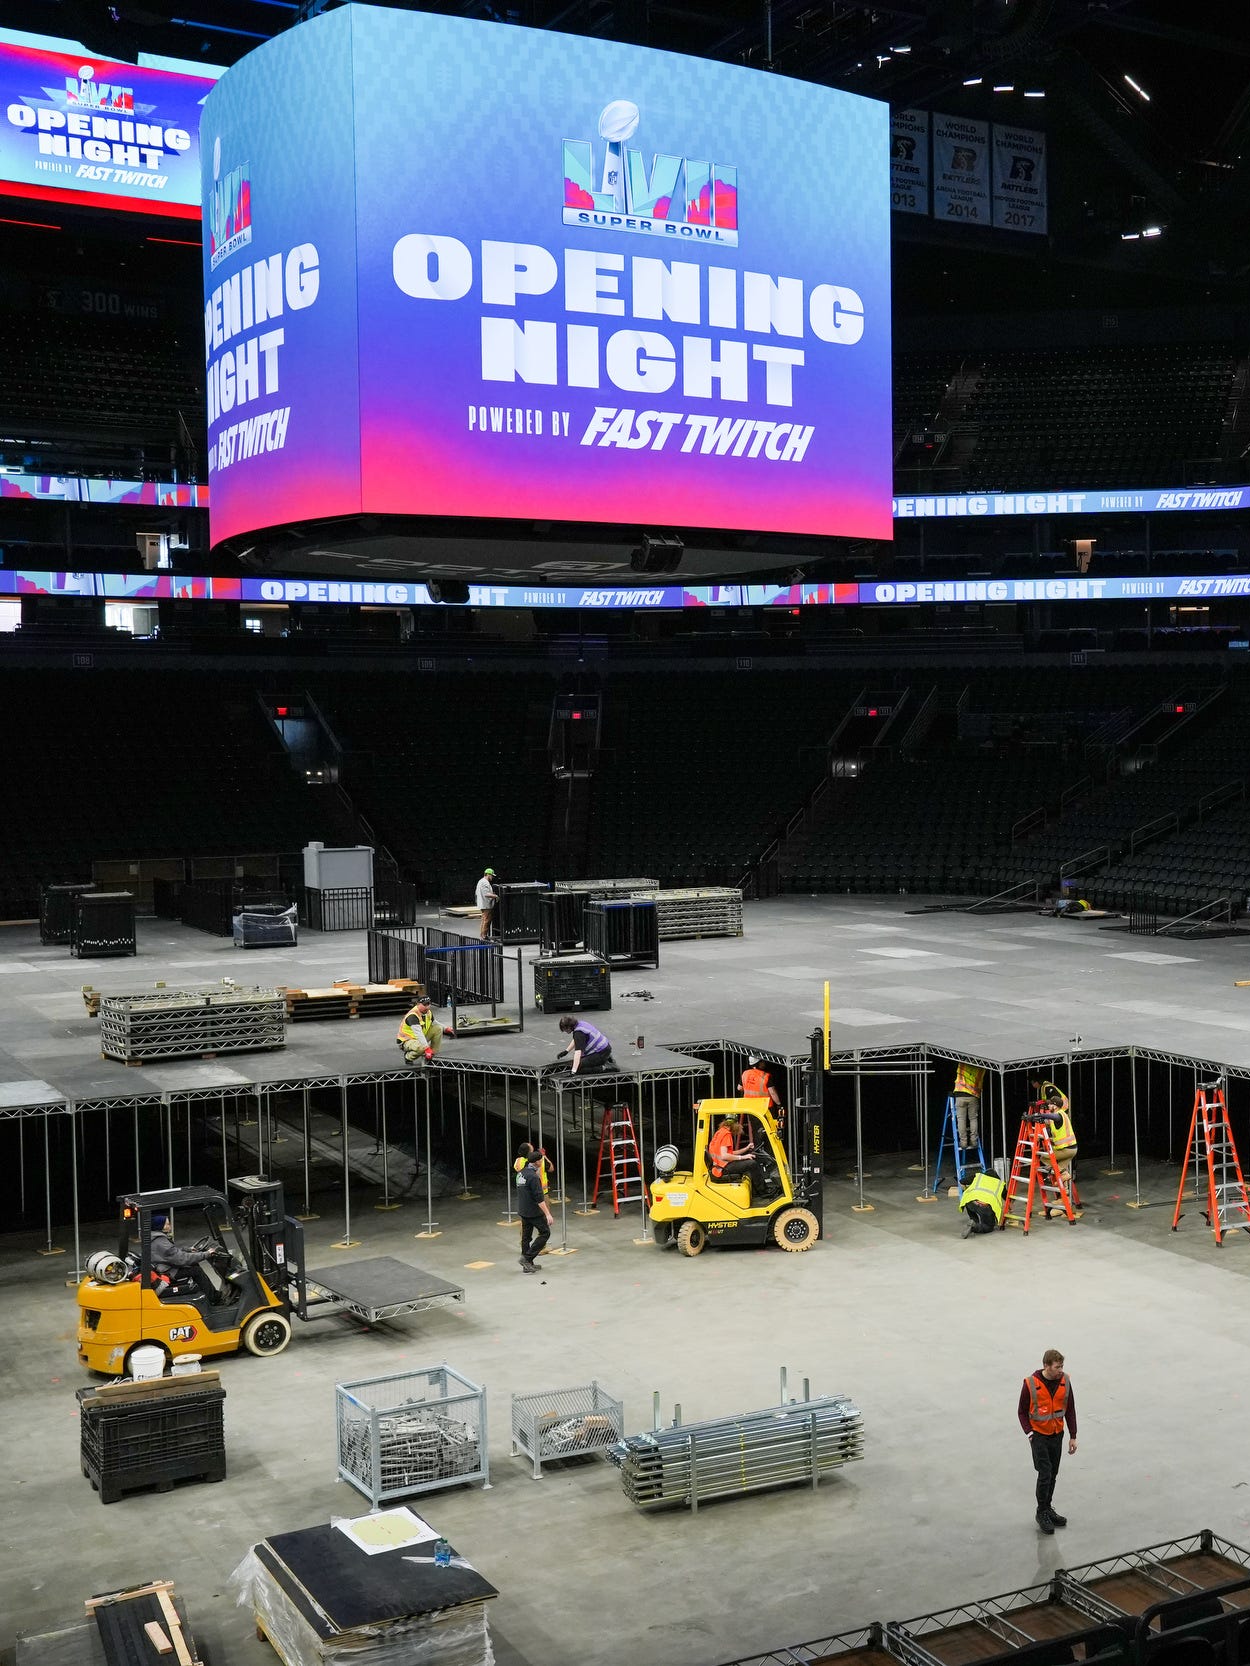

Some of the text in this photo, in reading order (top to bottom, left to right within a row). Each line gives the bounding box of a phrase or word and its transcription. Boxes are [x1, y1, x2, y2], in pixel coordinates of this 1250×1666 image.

[7, 104, 191, 150] OPENING
[936, 129, 986, 144] CHAMPIONS
[945, 122, 977, 133] WORLD
[1004, 132, 1034, 144] WORLD
[39, 132, 164, 170] NIGHT
[996, 140, 1043, 154] CHAMPIONS
[35, 160, 168, 189] POWERED BY FAST TWITCH
[893, 192, 916, 207] 013
[947, 203, 978, 218] 2014
[578, 212, 725, 242] SUPER BOWL
[1004, 212, 1035, 227] 2017
[393, 233, 864, 345] OPENING
[205, 243, 319, 366] PENING
[481, 316, 805, 407] NIGHT
[468, 405, 815, 462] POWERED BY FAST TWITCH
[893, 491, 1243, 517] ENING NIGHT POWERED BY FAST TWITCH
[261, 581, 664, 606] OPENING NHT POWERED BY FAST TWITCH
[875, 582, 1008, 602] OPENING
[1014, 580, 1107, 600] NIGHT
[1122, 583, 1152, 594] POWERED
[1155, 582, 1164, 594] BY
[1177, 579, 1214, 595] FAST
[707, 1221, 737, 1229] HYSTER
[168, 1325, 190, 1341] CAT
